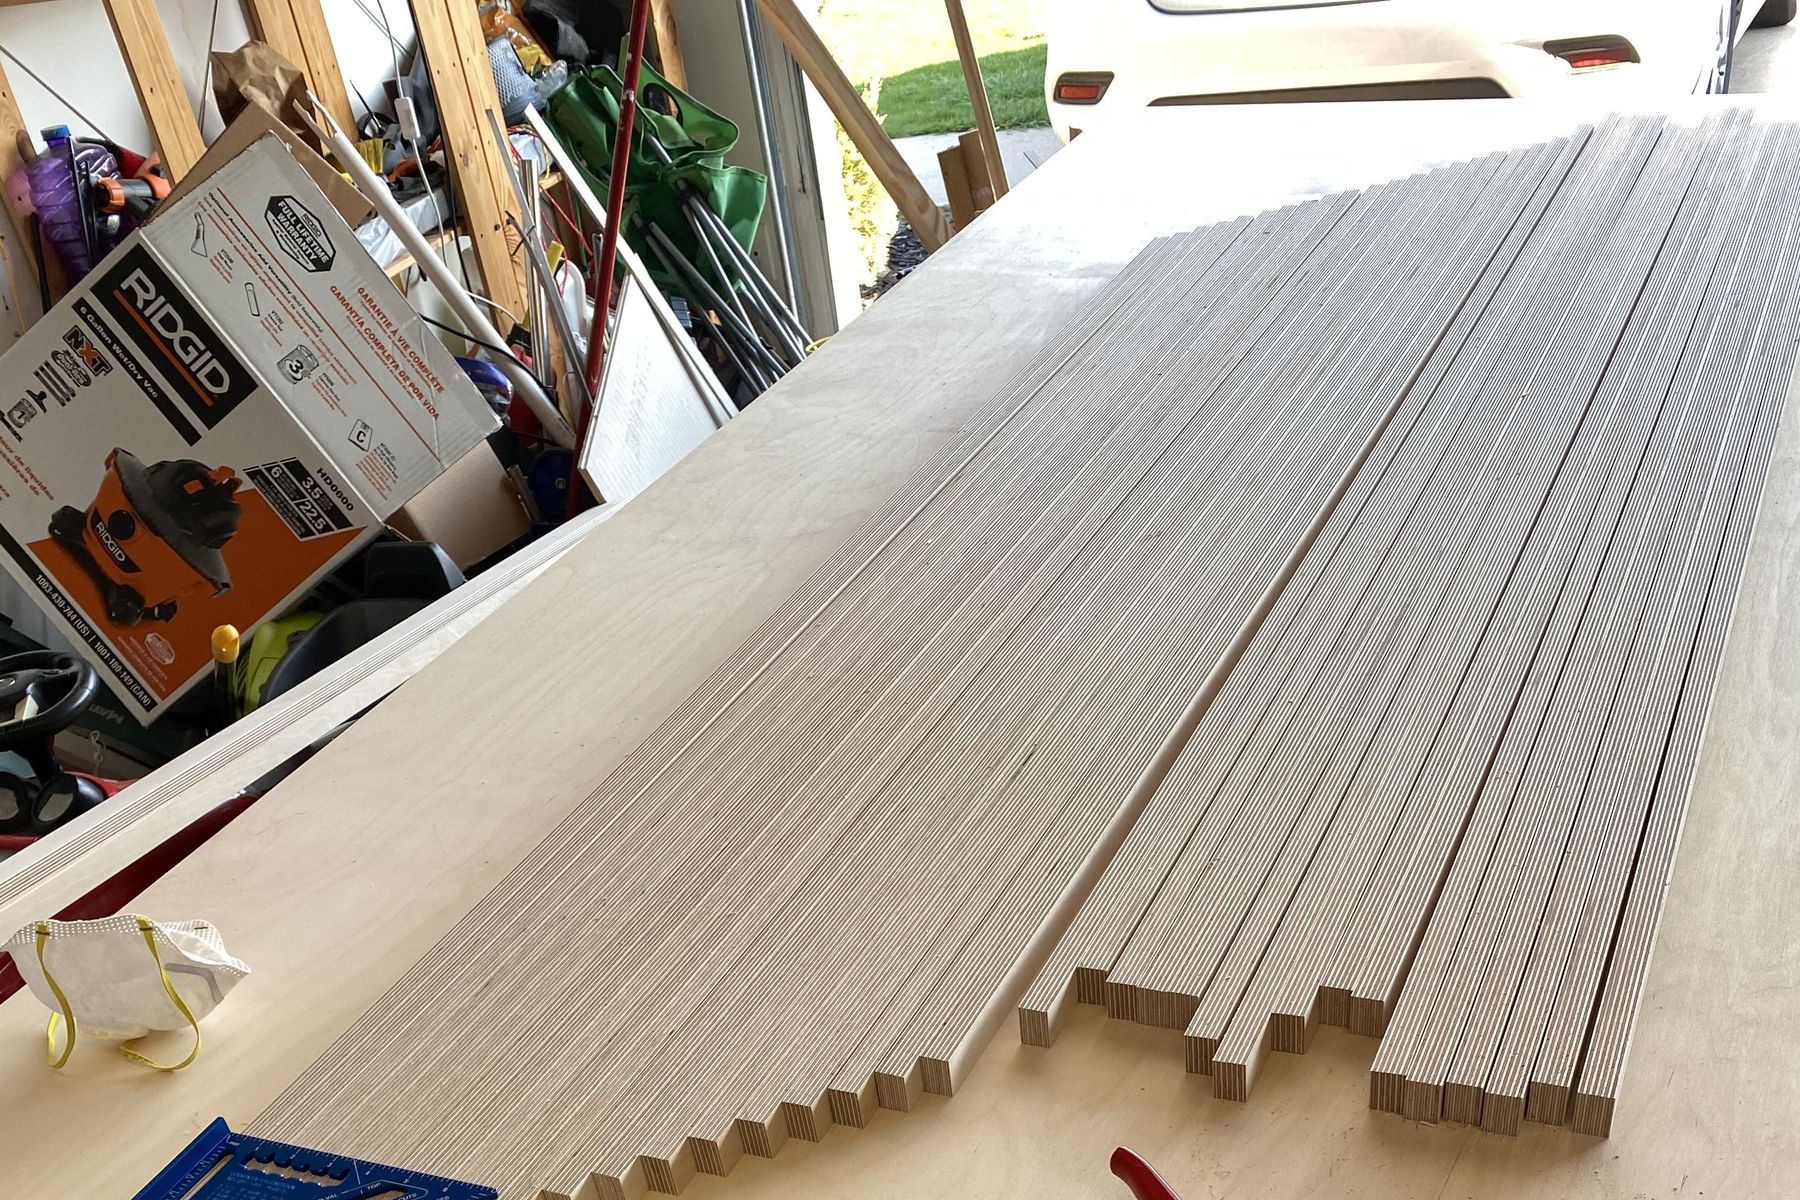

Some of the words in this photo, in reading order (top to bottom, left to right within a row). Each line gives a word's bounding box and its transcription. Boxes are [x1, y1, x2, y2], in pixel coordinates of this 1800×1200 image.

[207, 191, 229, 217] Optional
[228, 216, 258, 252] Accessories
[256, 252, 268, 265] Add
[275, 212, 317, 261] WARRANTY
[277, 200, 298, 225] FULL
[295, 222, 329, 263] LIFETIME
[121, 270, 231, 397] RIDGID
[356, 286, 393, 329] GARANTIE
[395, 335, 411, 351] VIE
[63, 327, 110, 377] NXT
[79, 305, 87, 314] 6
[85, 313, 113, 343] Gallon
[110, 343, 143, 380] Wet/Dry
[141, 379, 159, 398] Vac
[287, 358, 305, 375] 3
[328, 283, 368, 328] GARANTÍA
[362, 326, 400, 370] COMPLETA
[397, 369, 410, 382] DE
[407, 381, 425, 400] POR
[421, 398, 441, 421] VIDA
[353, 429, 368, 444] C
[269, 464, 283, 479] 6
[300, 475, 324, 500] 3.5
[315, 467, 354, 511] HD0600
[298, 499, 327, 531] 22.5
[91, 521, 129, 563] RIDGID
[33, 573, 77, 622] 1003-430-744
[72, 617, 91, 637] (US)
[128, 682, 152, 707] (CAN)
[366, 1182, 382, 1191] TOP
